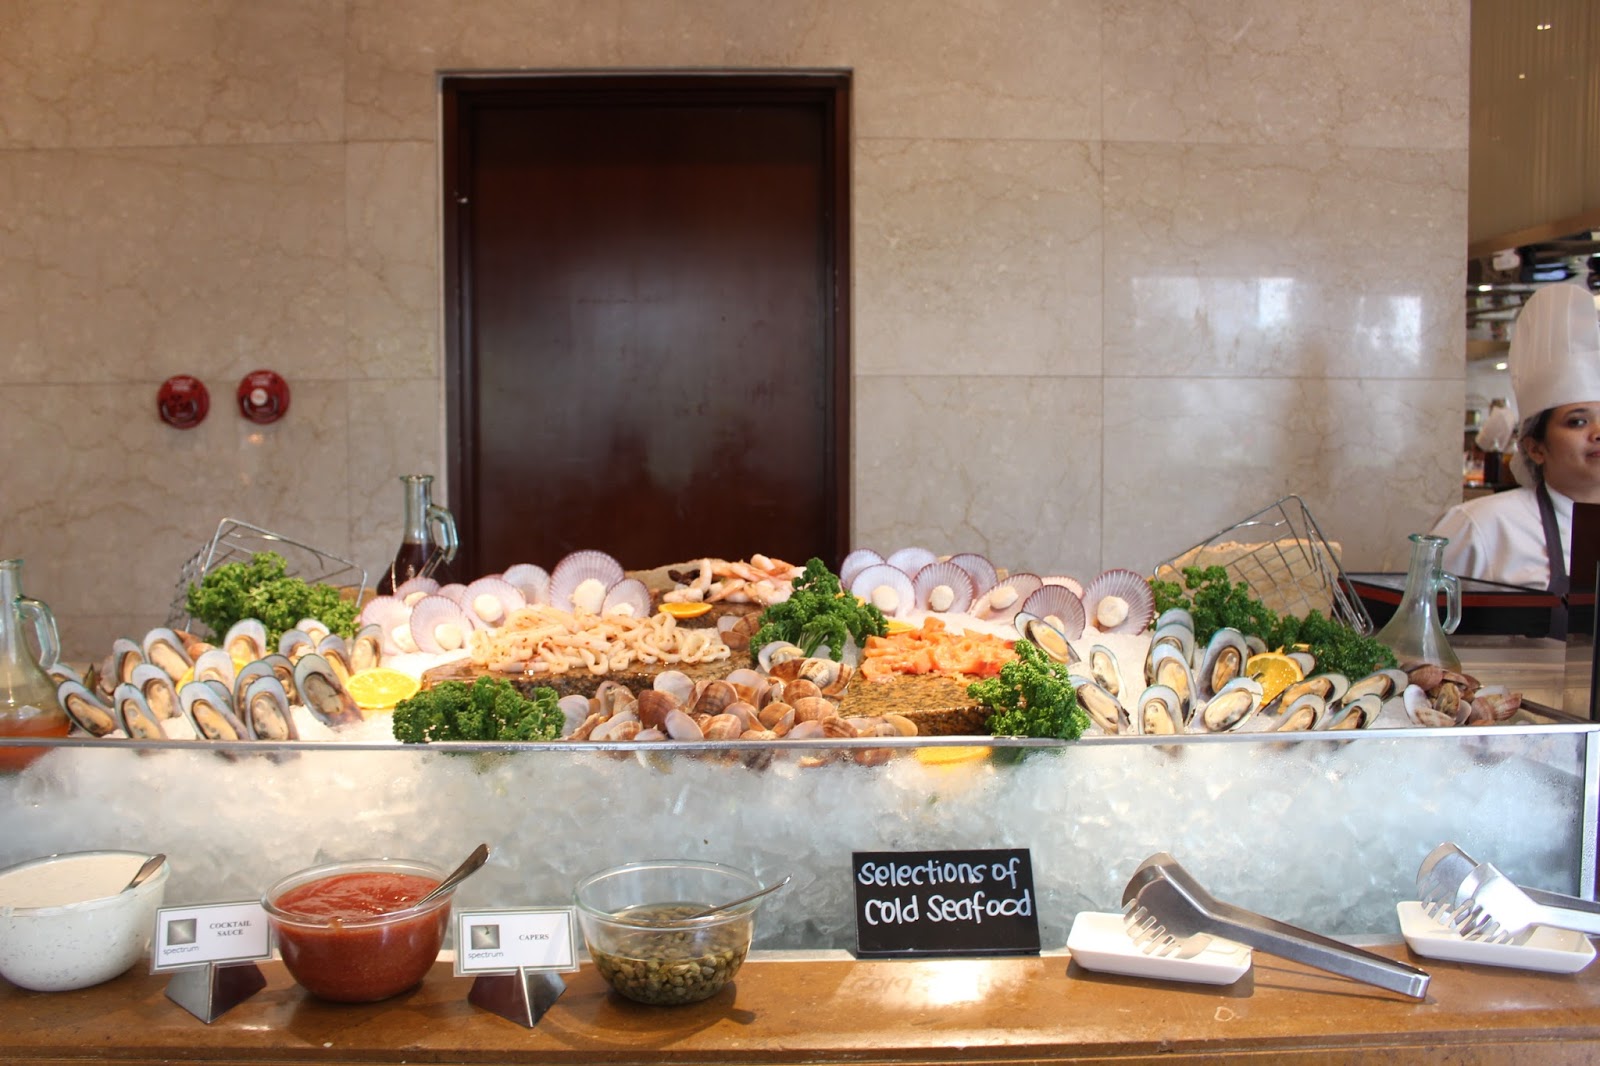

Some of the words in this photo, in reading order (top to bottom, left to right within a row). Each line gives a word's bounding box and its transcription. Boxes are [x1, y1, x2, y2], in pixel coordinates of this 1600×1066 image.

[858, 859, 987, 887] Selections
[991, 857, 1021, 889] of
[926, 888, 1032, 924] Seafood
[209, 921, 251, 930] COCKTAIL
[217, 929, 244, 937] SAUCE
[163, 946, 200, 955] spectrum
